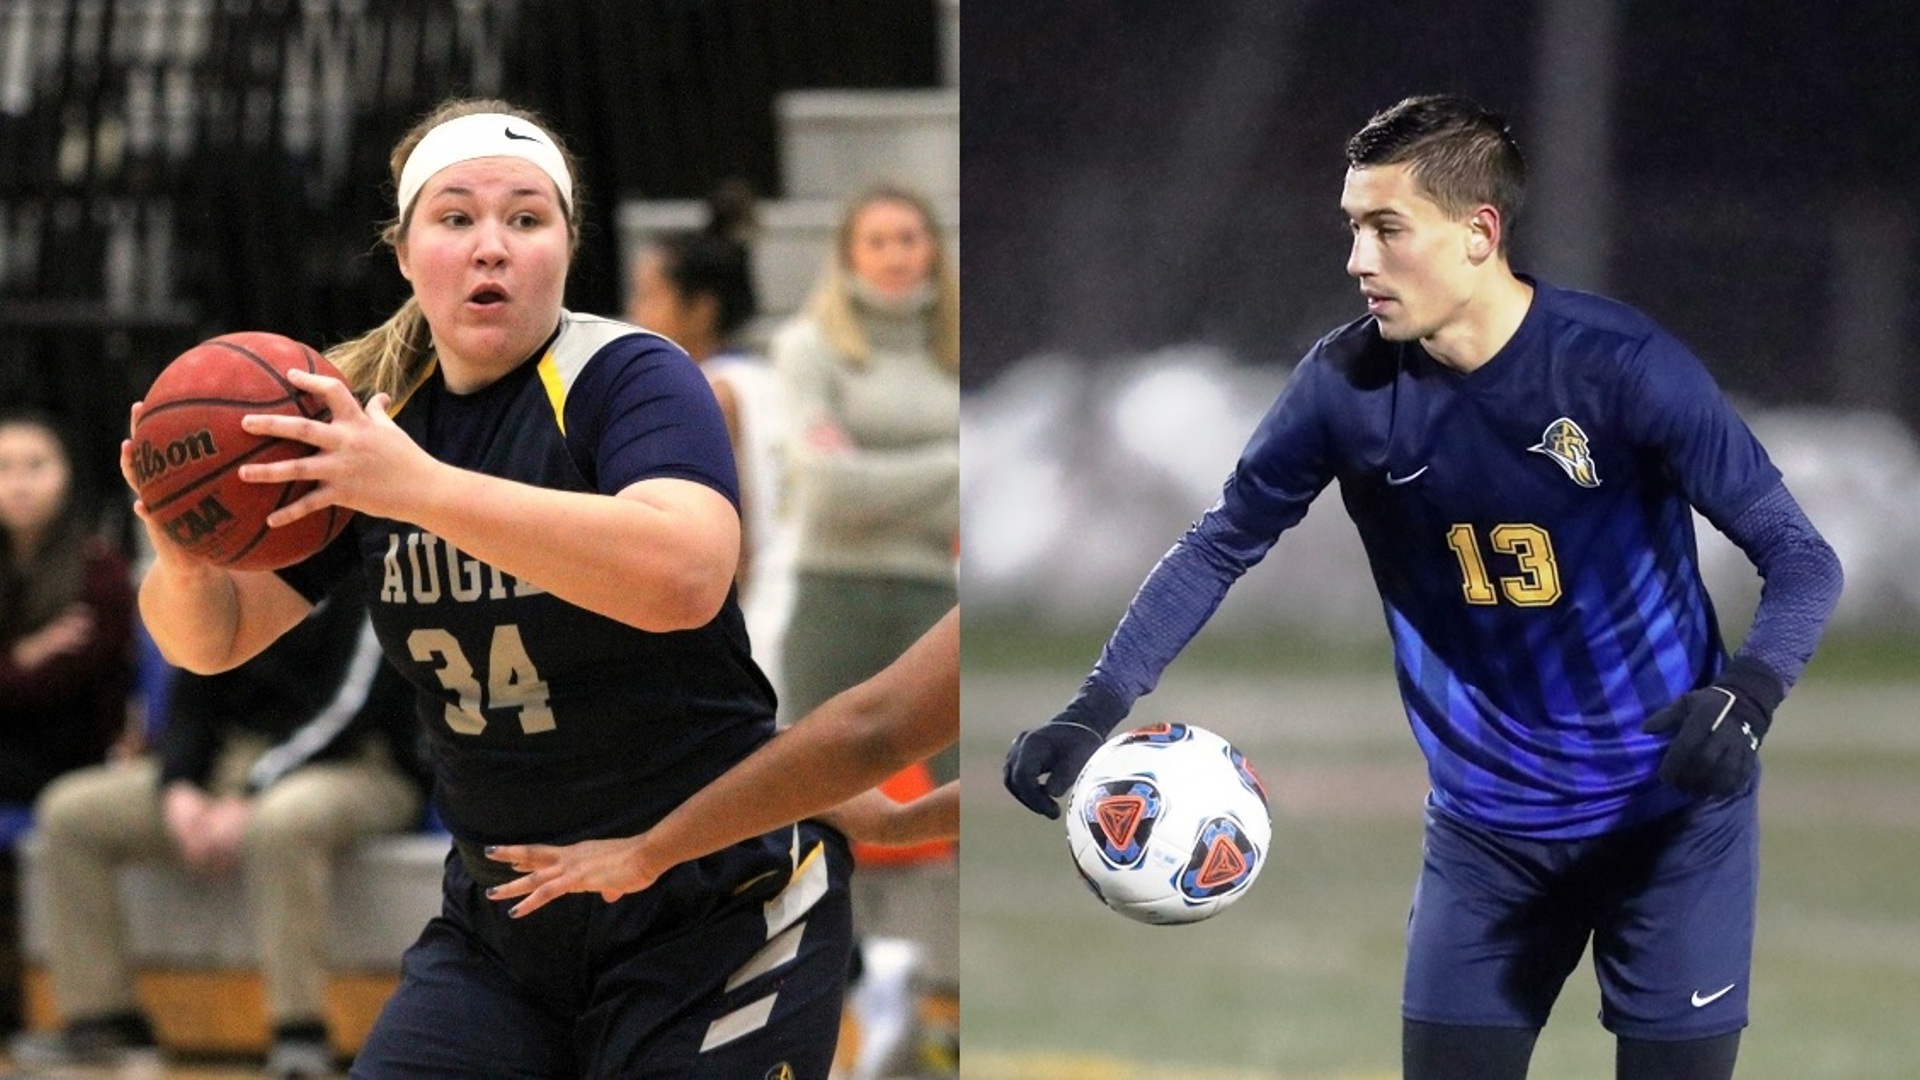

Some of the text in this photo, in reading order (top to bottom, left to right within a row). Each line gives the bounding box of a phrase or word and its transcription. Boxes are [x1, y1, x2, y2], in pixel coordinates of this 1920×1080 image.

[131, 429, 218, 483] ilson
[380, 532, 546, 604] AUGI
[1446, 523, 1563, 607] 13
[406, 623, 557, 735] 34
